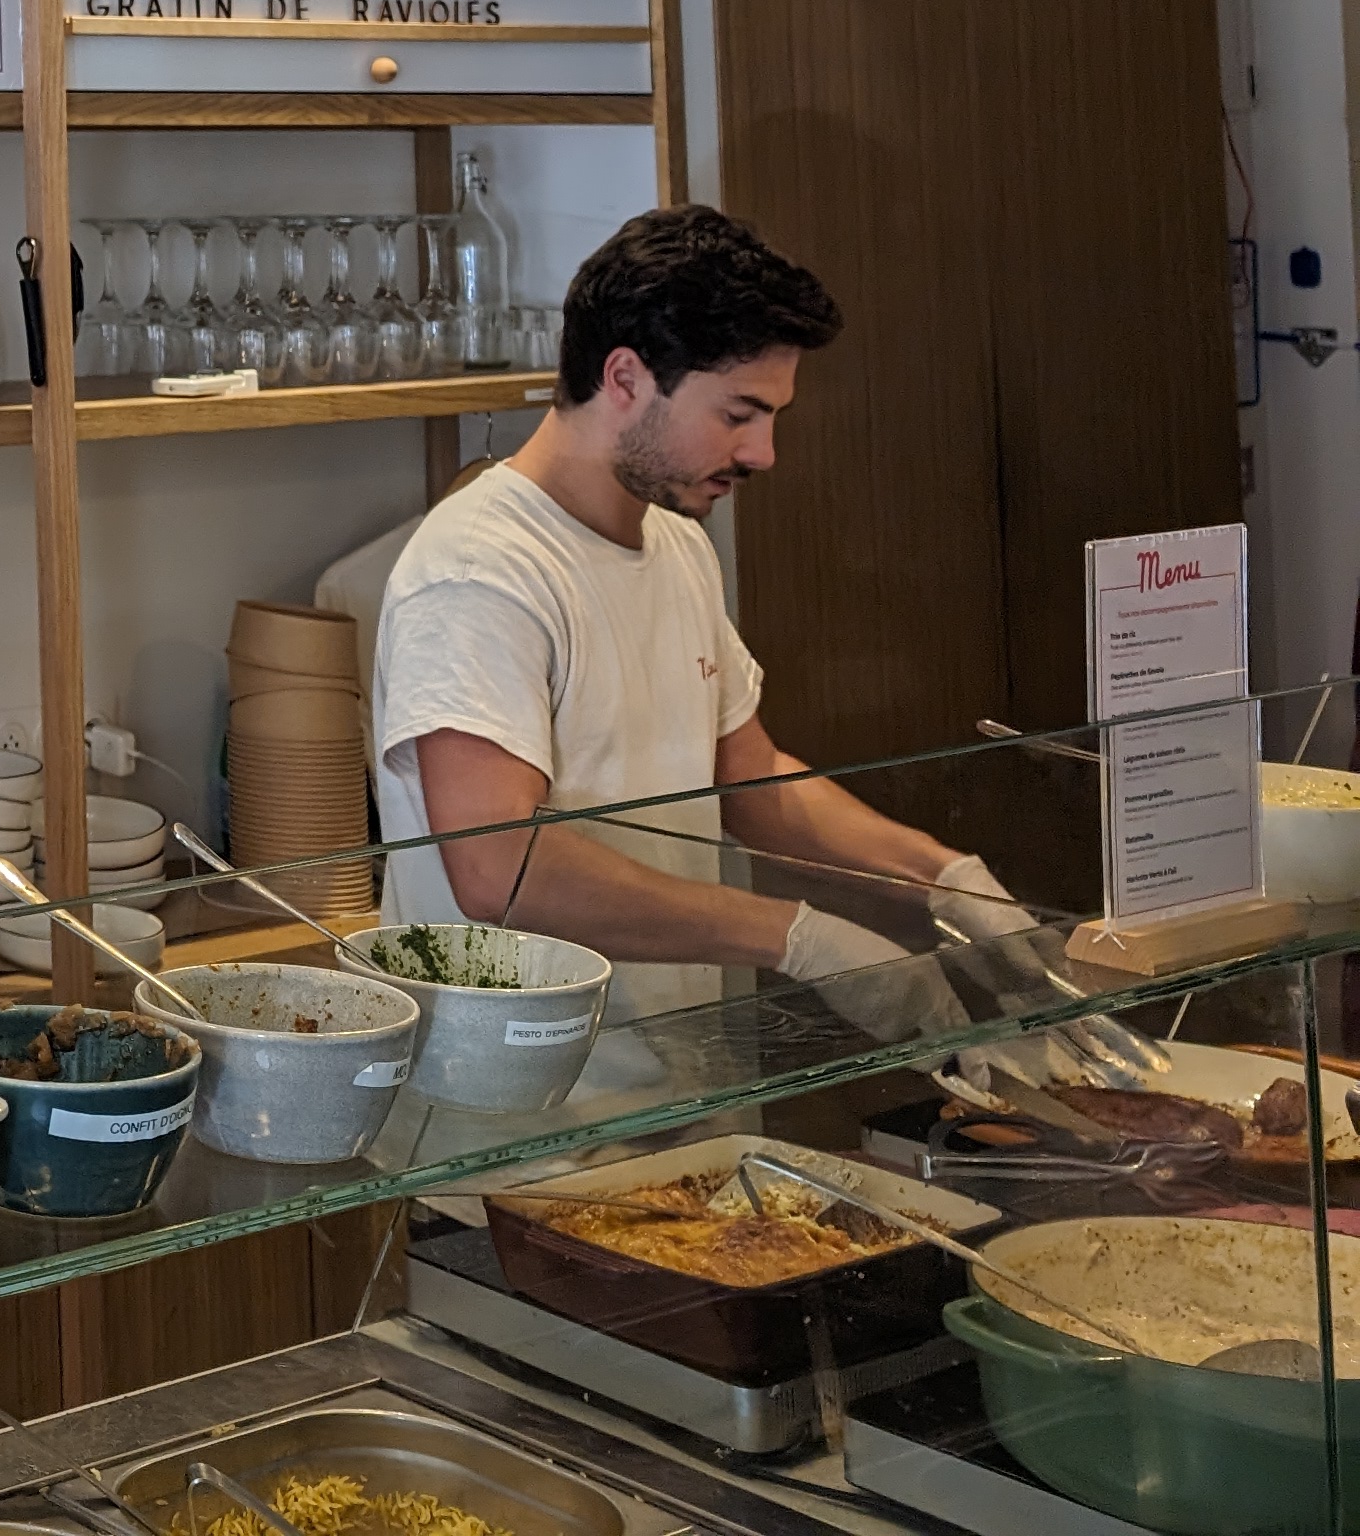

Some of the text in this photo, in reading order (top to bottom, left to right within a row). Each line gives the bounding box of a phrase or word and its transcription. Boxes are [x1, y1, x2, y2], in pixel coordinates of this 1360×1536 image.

[1136, 551, 1202, 594] Menu
[513, 1030, 541, 1038] PESTO
[110, 1118, 158, 1134] CONFIT
